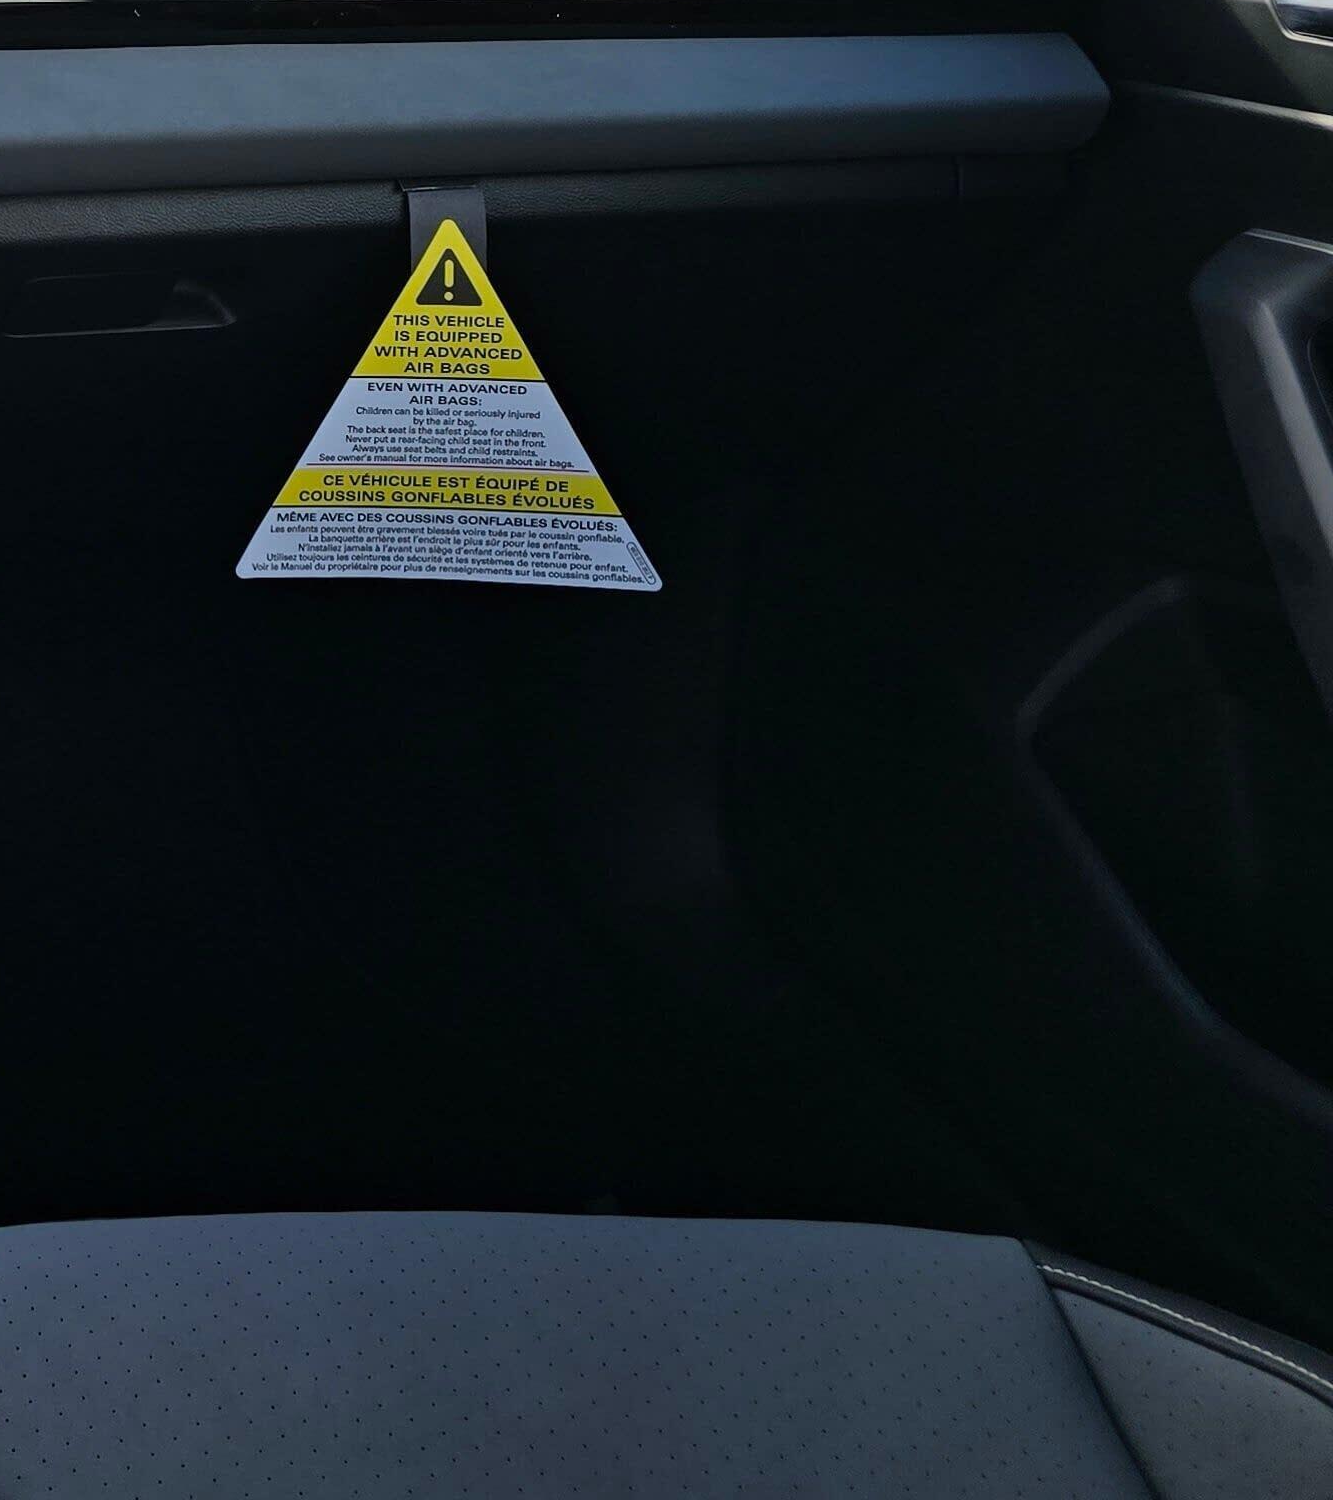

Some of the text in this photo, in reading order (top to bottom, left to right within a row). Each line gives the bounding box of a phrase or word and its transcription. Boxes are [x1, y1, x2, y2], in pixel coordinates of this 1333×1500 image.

[393, 315, 505, 328] THIS VEHICLE
[395, 331, 502, 343] IS EQUIPPED
[374, 346, 522, 360] WITH ADVANCED
[404, 362, 490, 374] AIR BAGS
[368, 383, 527, 395] EVEN WITH ADVANCED
[409, 396, 482, 406] AIR BAGS:
[356, 406, 392, 415] Children
[413, 407, 423, 415] be
[426, 407, 449, 416] killed
[465, 408, 505, 420] seriously
[508, 409, 540, 420] injured
[413, 416, 477, 428] by the air bag.
[347, 425, 545, 438] The back seat is the safest place for children.
[346, 434, 371, 443] Never
[374, 435, 389, 445] put
[398, 435, 445, 446] rear-facing
[448, 436, 470, 445] child
[473, 437, 491, 445] seat
[494, 437, 502, 446] in
[505, 438, 519, 446] the
[521, 438, 546, 447] front.
[352, 443, 384, 454] Always
[404, 444, 423, 453] seat
[425, 445, 446, 453] belts
[449, 445, 466, 454] and
[468, 446, 490, 455] child
[493, 447, 538, 456] restraints.
[319, 453, 335, 461] See
[337, 453, 371, 462] owner's
[374, 453, 406, 462] manual
[409, 454, 421, 462] for
[451, 455, 503, 464] information
[506, 456, 532, 466] about
[535, 457, 547, 466] air
[550, 458, 574, 469] bags.
[323, 473, 568, 492] CE VÉHICULE EST ÉQUIPÉ DE
[299, 490, 594, 509] COUSSINS GONFLABLES ÉVOLUÉS
[277, 511, 618, 531] MÊME AVEC DES COUSSINS GONFLABLES ÉVOLUÉS:
[270, 524, 284, 533] Les
[287, 524, 318, 533] enfants
[321, 524, 355, 535] peuvent
[357, 524, 374, 533] être
[377, 525, 424, 536] gravement
[427, 526, 460, 535] blessés
[463, 527, 485, 536] voire
[488, 528, 508, 537] tués
[511, 531, 526, 540] par
[539, 530, 575, 540] coussin
[578, 532, 624, 545] gonflable.
